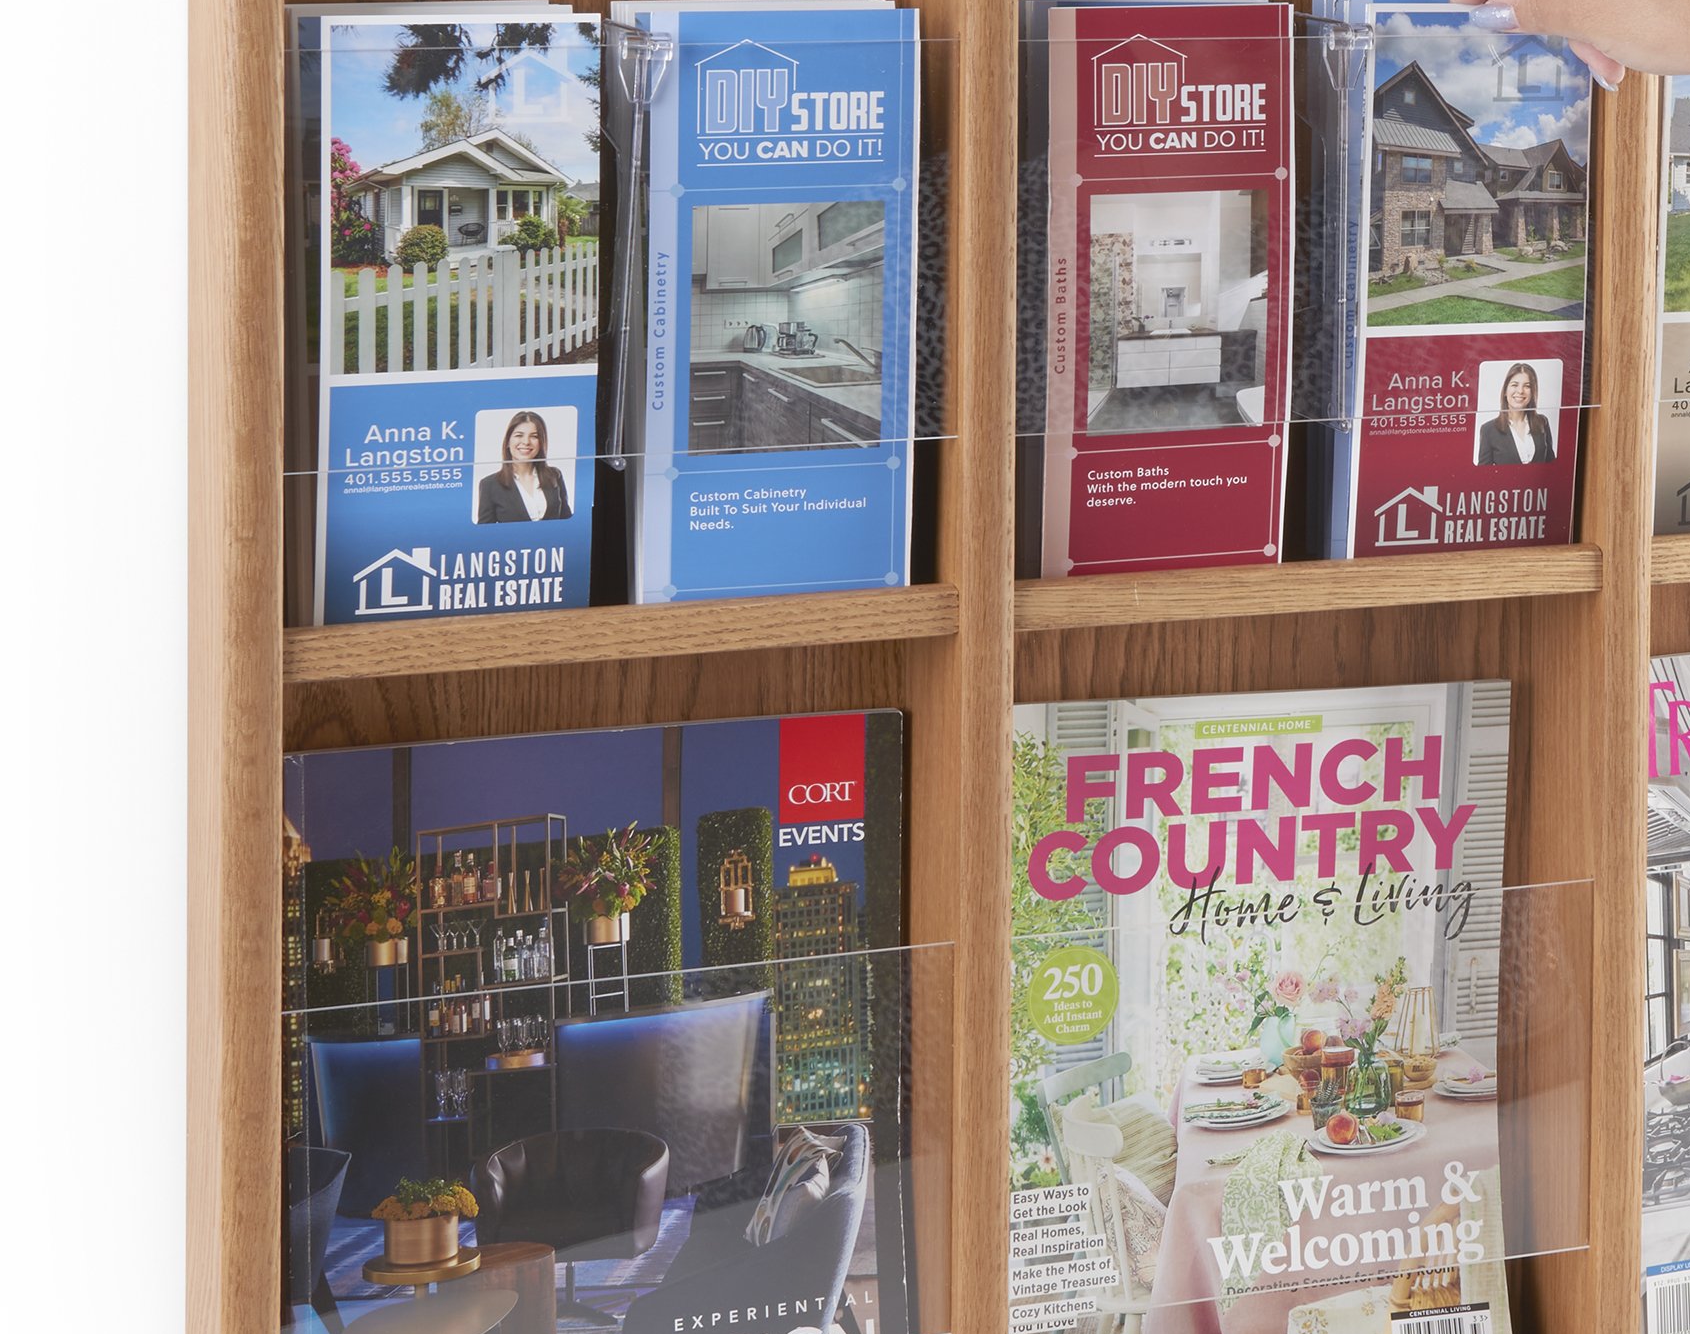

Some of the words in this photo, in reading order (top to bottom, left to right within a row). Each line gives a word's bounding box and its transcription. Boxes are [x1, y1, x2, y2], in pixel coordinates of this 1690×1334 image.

[705, 68, 788, 134] DIY
[791, 91, 885, 132] STORE
[1102, 63, 1177, 125] DIY
[1180, 83, 1266, 122] STORE
[698, 142, 750, 160] YOU
[756, 140, 809, 159] CAN
[816, 140, 851, 158] DO
[858, 138, 882, 156] IT!
[1096, 133, 1143, 151] YOU
[1149, 132, 1197, 149] CAN
[1204, 131, 1235, 148] DO
[1243, 129, 1265, 146] IT!
[653, 251, 670, 338] Cabinetry
[651, 345, 665, 411] Custom
[364, 424, 432, 444] Anna
[441, 421, 465, 440] K.
[346, 446, 464, 468] Langston
[344, 468, 463, 485] 401.555.5555
[1087, 469, 1133, 481] Custom
[1137, 466, 1170, 478] Baths
[1087, 483, 1114, 494] With
[1117, 481, 1137, 492] the
[1140, 478, 1187, 491] modern
[1190, 475, 1223, 488] touch
[1226, 475, 1248, 487] you
[690, 490, 740, 503] Custom
[744, 487, 807, 500] Cabinetry
[1086, 496, 1137, 508] deserve.
[690, 505, 720, 517] Built
[723, 504, 738, 515] To
[741, 502, 767, 514] Suit
[771, 501, 800, 513] Your
[803, 497, 867, 511] Individual
[690, 519, 734, 531] Needs.
[440, 547, 565, 580] LANGSTON
[439, 581, 487, 610] REAL
[494, 576, 563, 606] ESTATE
[1202, 722, 1275, 735] CENTENNIAL
[1278, 720, 1311, 730] HOME
[1066, 735, 1441, 824] FRENCH
[788, 781, 855, 804] CORT
[779, 822, 865, 847] EVENTS
[1027, 804, 1477, 901] COUNTRY
[1170, 866, 1302, 945] Home
[1313, 881, 1346, 925] &
[1354, 862, 1480, 940] Living
[1043, 963, 1103, 1000] 250
[1054, 1001, 1080, 1011] Ideas
[1082, 1000, 1093, 1008] to
[1044, 1014, 1064, 1024] Add
[1066, 1010, 1102, 1021] Instant
[1056, 1023, 1090, 1034] Charm
[1013, 1192, 1040, 1204] Easy
[1043, 1188, 1074, 1201] Ways
[1077, 1186, 1089, 1196] to
[1278, 1175, 1429, 1223] Warm
[1441, 1160, 1482, 1204] &
[1013, 1208, 1033, 1219] Get
[1036, 1205, 1055, 1217] the
[1058, 1201, 1087, 1214] Look
[1207, 1211, 1484, 1280] Welcoming
[674, 1292, 875, 1333] EXPERIENTIAL
